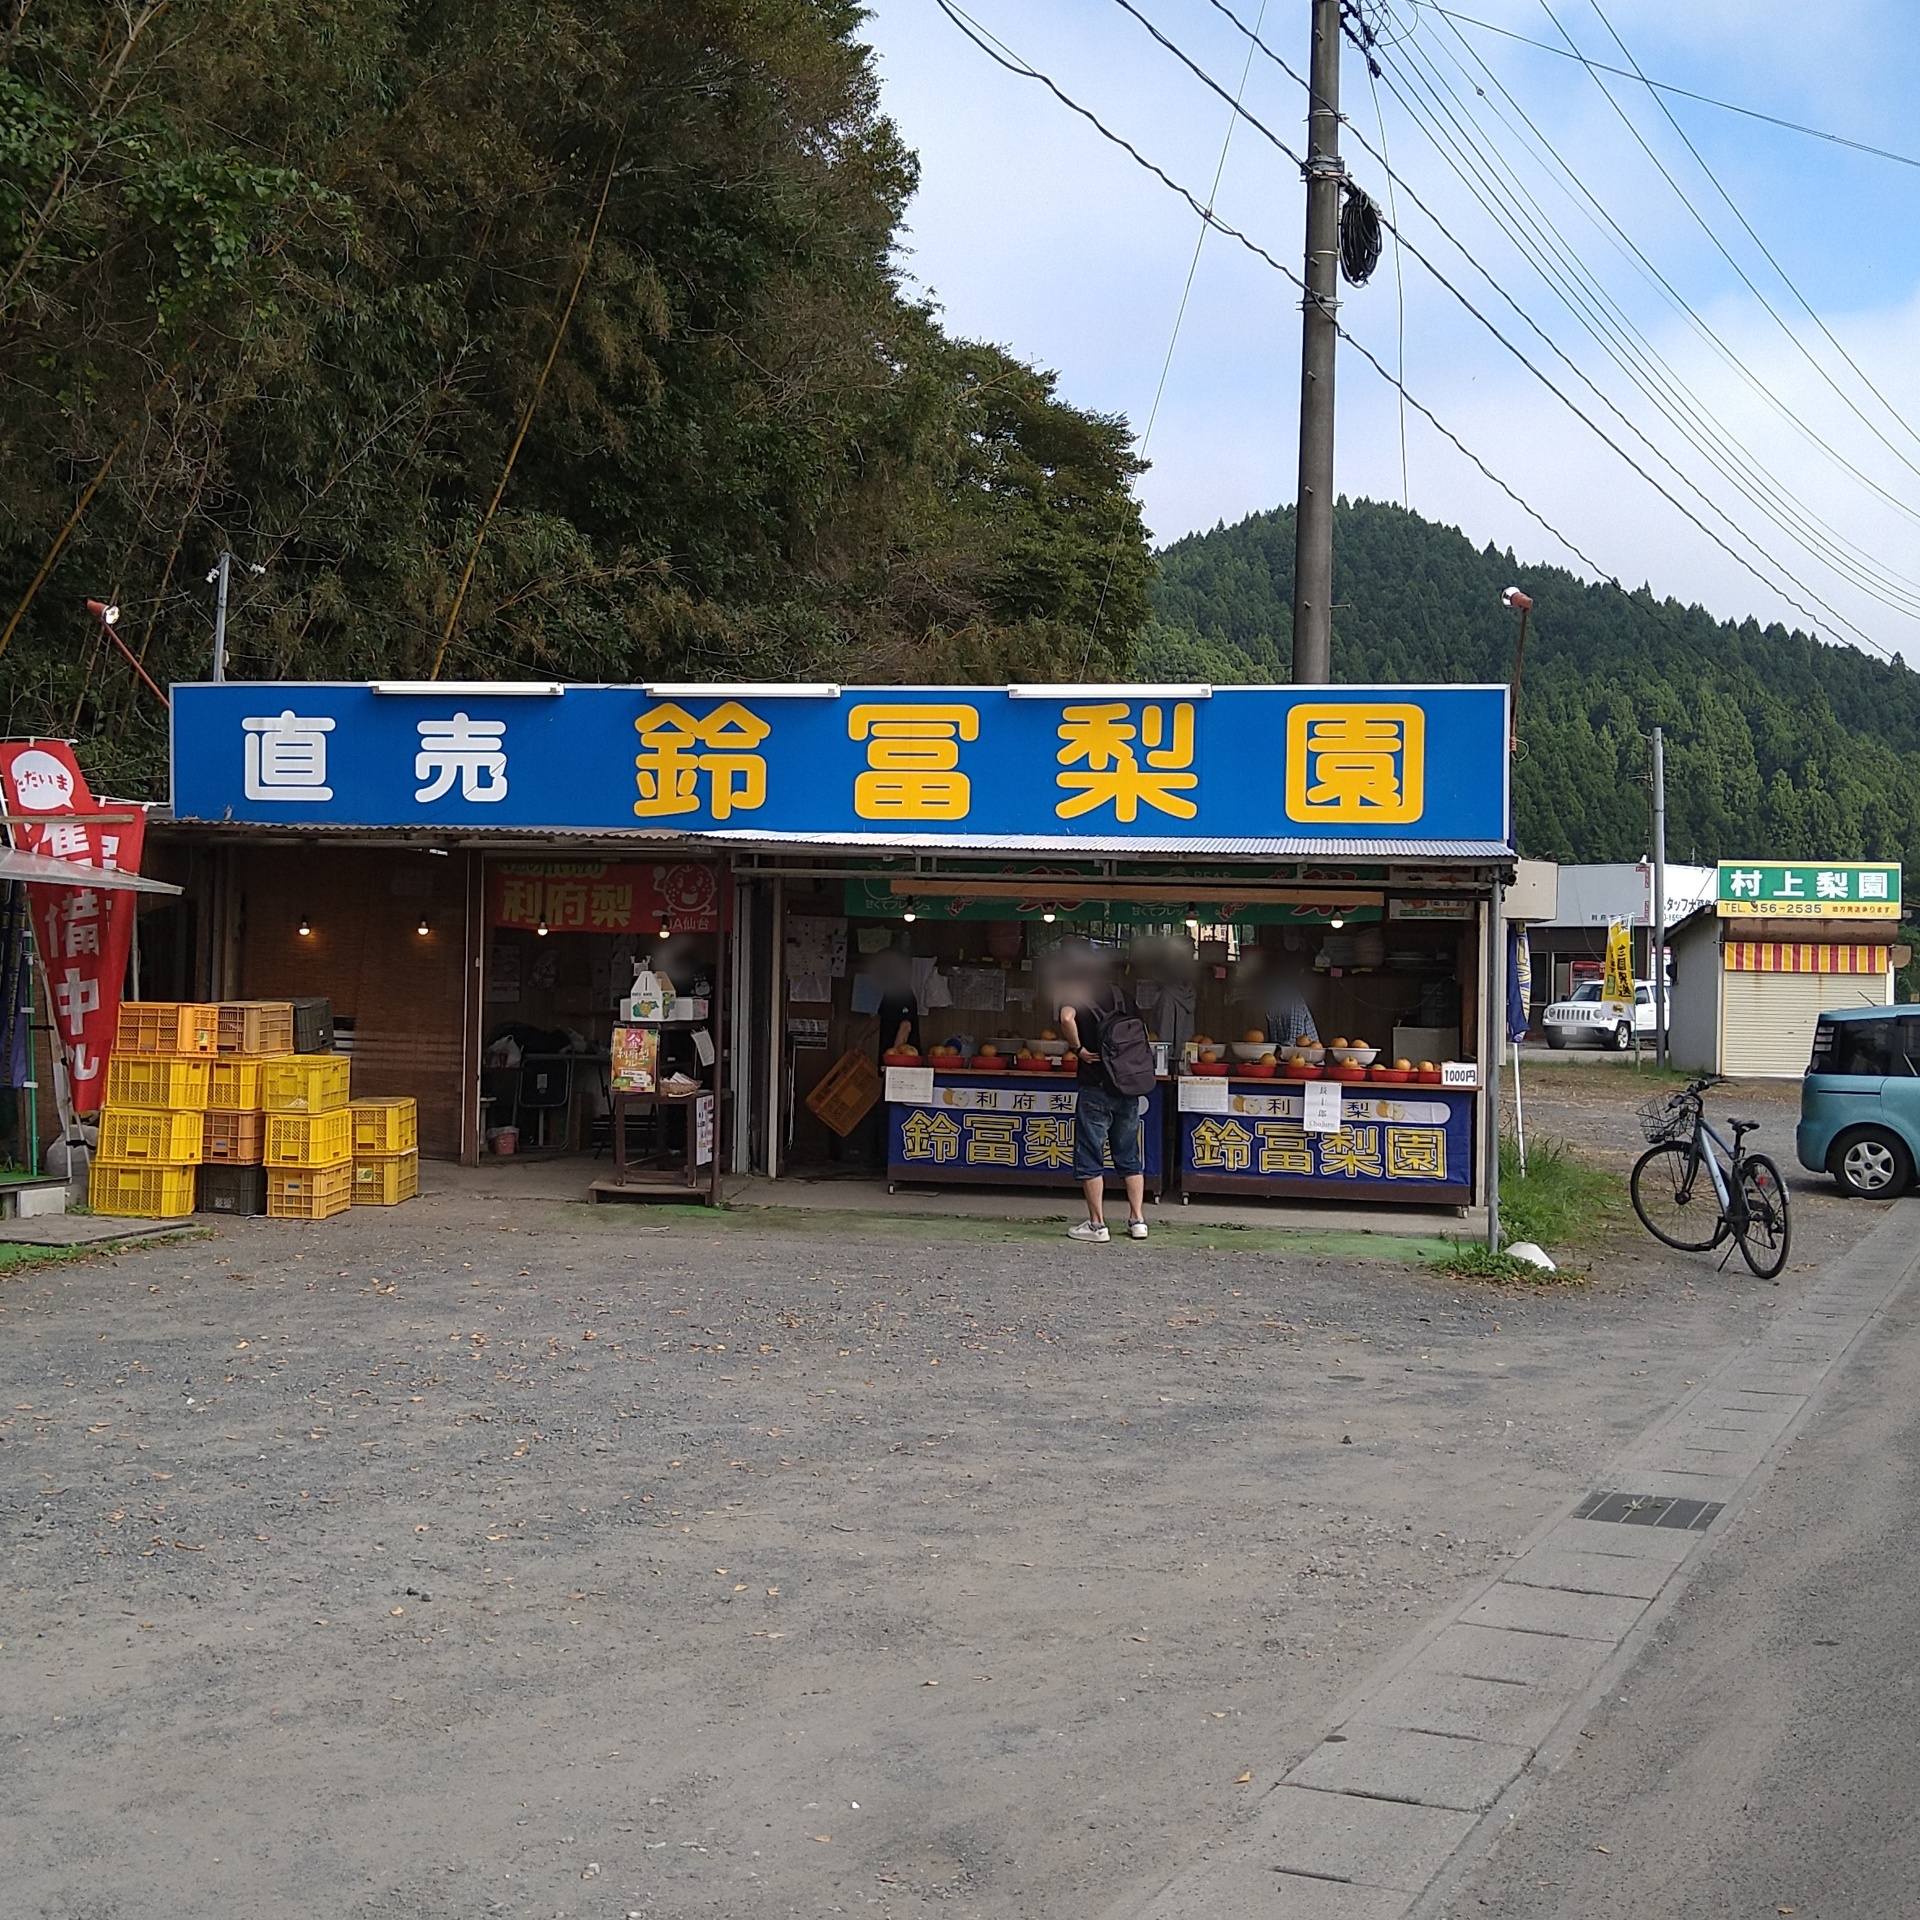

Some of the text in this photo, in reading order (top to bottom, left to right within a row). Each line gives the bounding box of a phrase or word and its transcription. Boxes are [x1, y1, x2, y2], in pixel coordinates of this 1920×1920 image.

[241, 710, 508, 803] 直売
[1730, 869, 1888, 899] 村上梨園
[503, 880, 632, 928] 利府梨
[866, 899, 931, 911] 甘くてフレシュ
[1751, 902, 1822, 914] 356-2535
[667, 915, 710, 931] JA仙台
[1445, 1069, 1476, 1083] 1000円
[976, 1090, 1074, 1111] 利府梨
